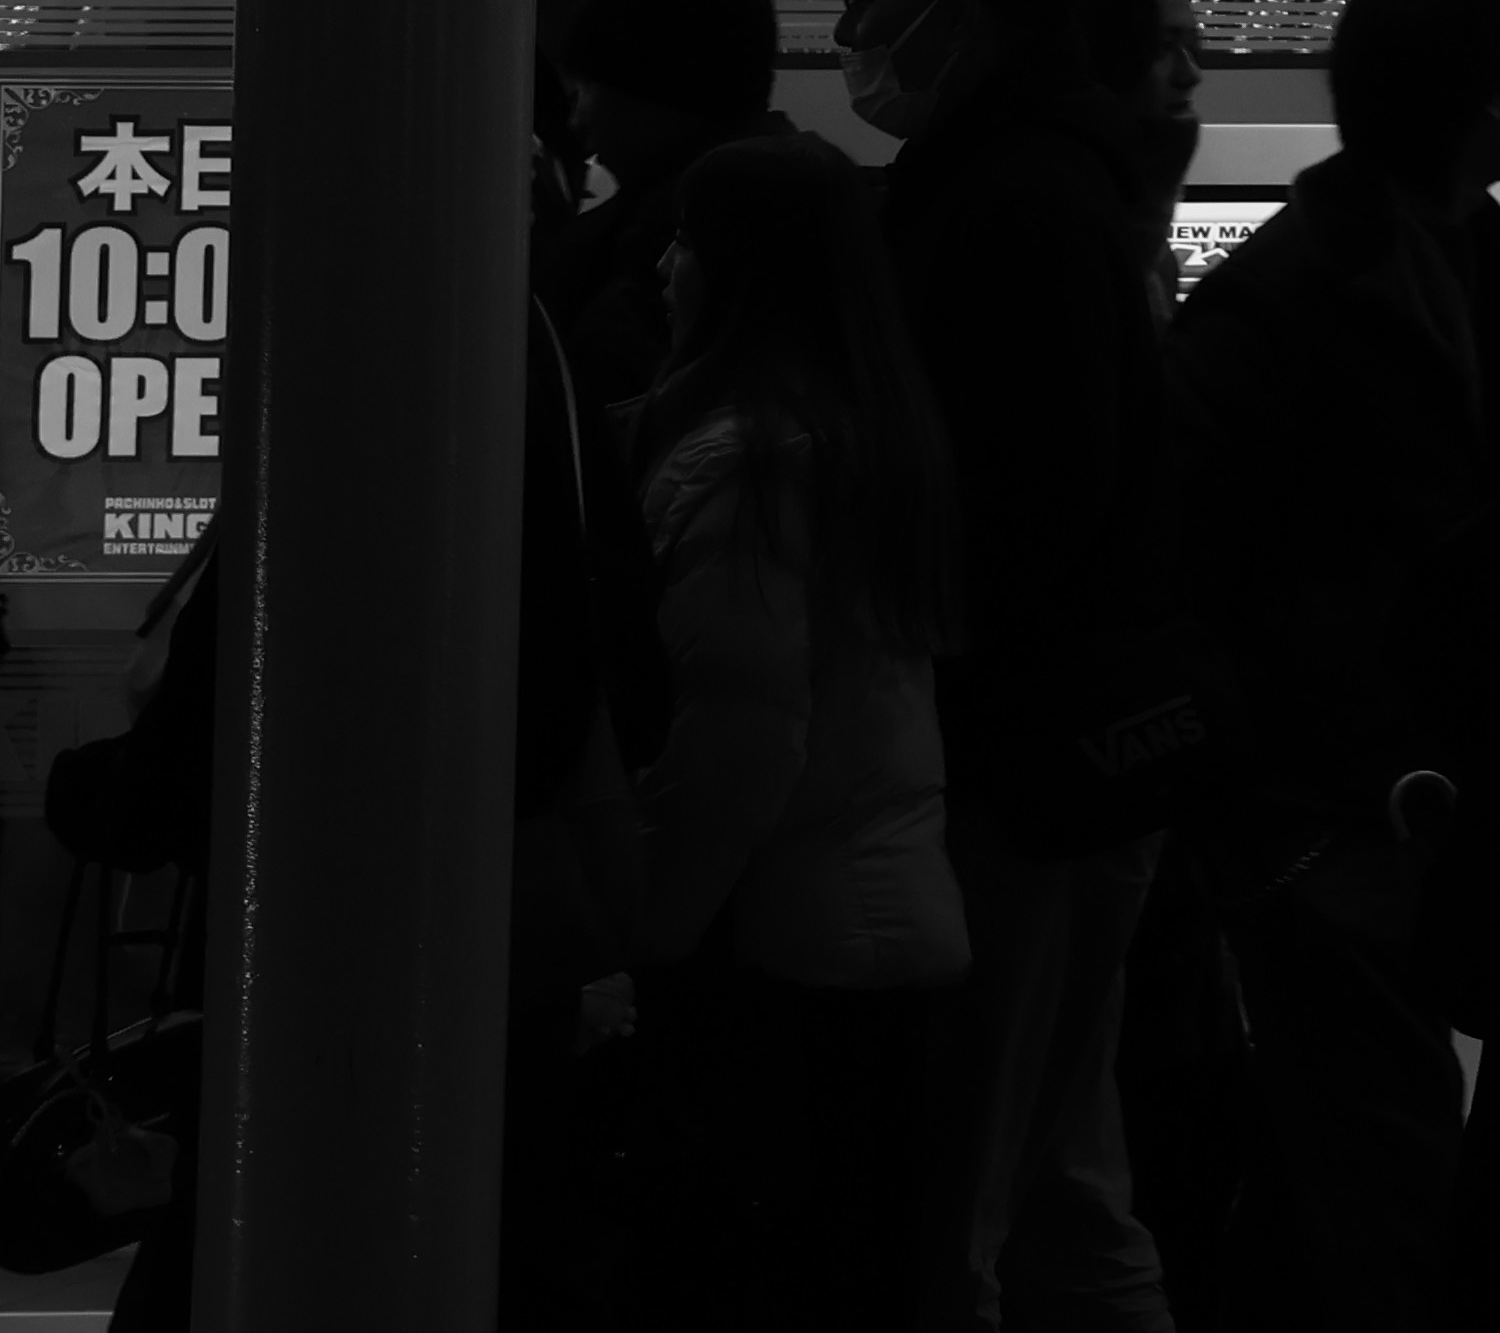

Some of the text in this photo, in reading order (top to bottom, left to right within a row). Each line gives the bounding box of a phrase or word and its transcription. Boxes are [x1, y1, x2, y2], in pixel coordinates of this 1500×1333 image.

[1171, 226, 1211, 239] EW
[11, 225, 231, 343] 10:0
[38, 354, 222, 460] OPE
[1075, 693, 1208, 779] VANS
